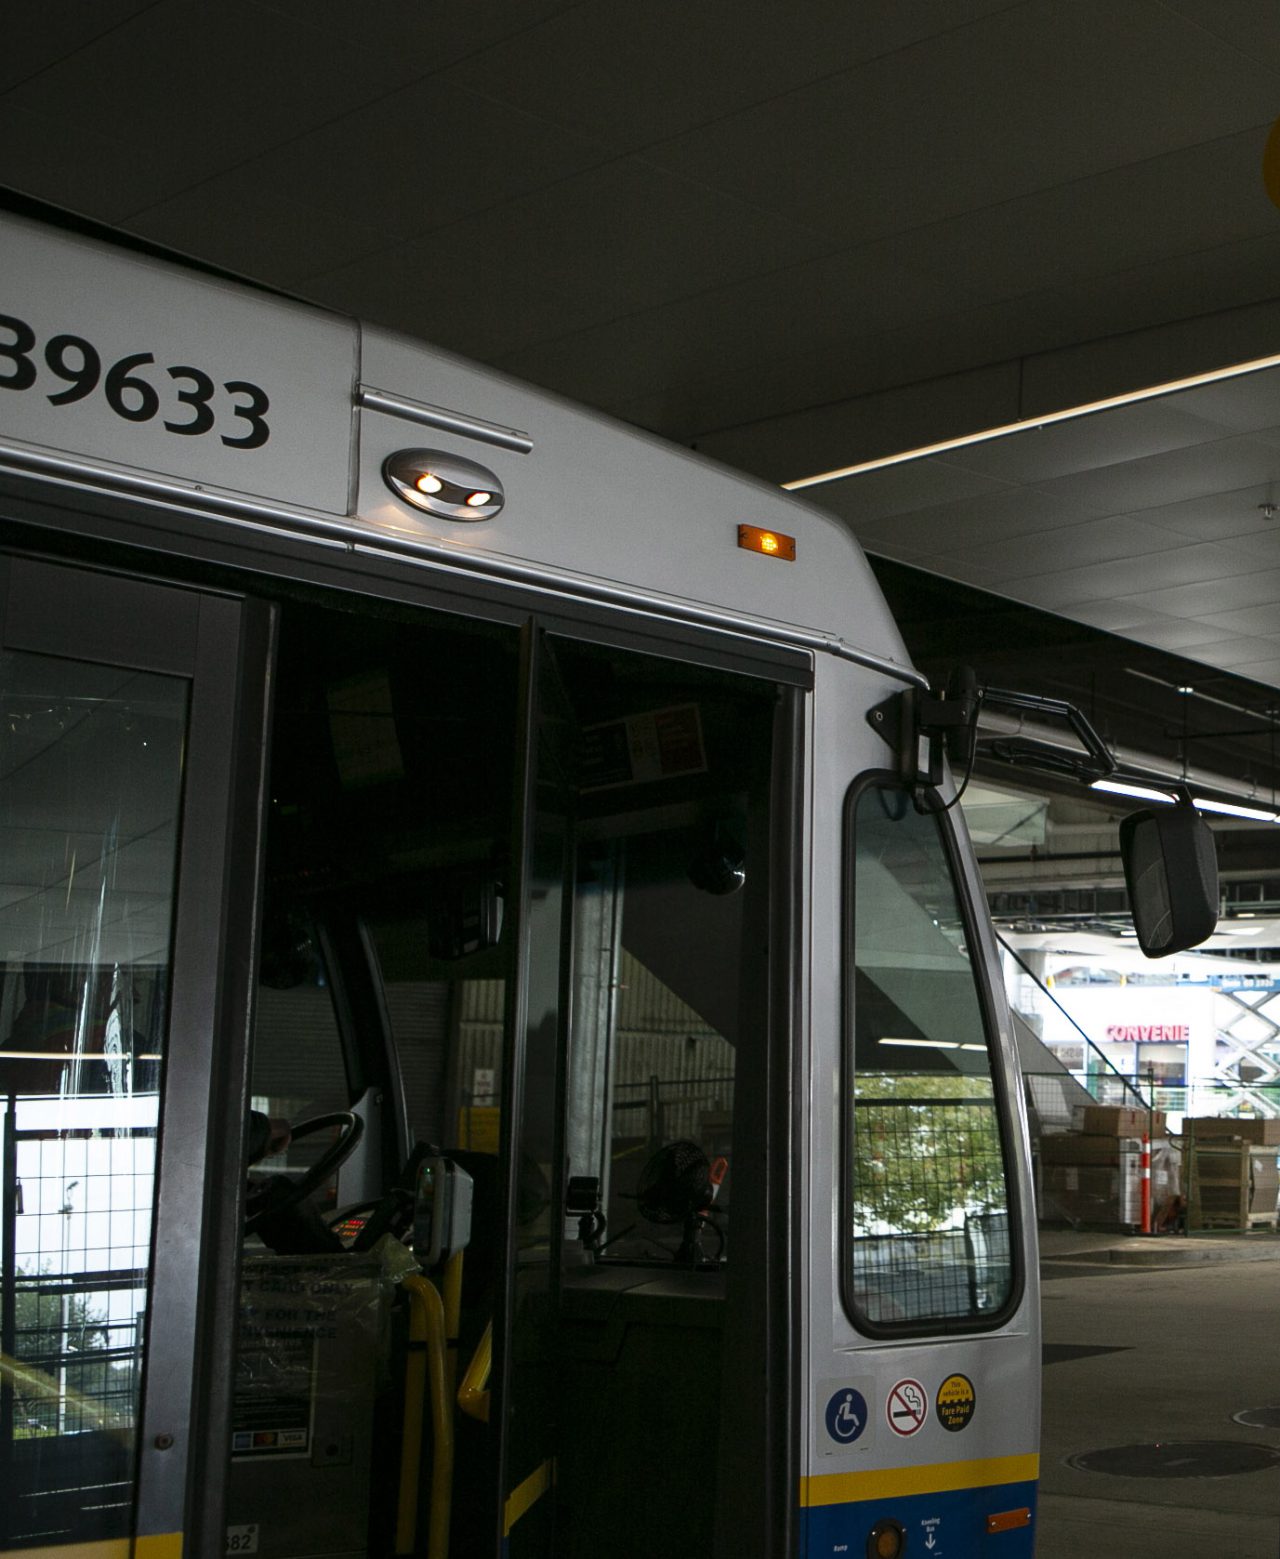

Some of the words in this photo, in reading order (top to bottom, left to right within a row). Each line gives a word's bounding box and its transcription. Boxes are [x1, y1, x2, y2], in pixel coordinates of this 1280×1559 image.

[942, 1407, 956, 1416] Fare
[956, 1404, 970, 1414] Paid
[948, 1416, 964, 1425] Zone
